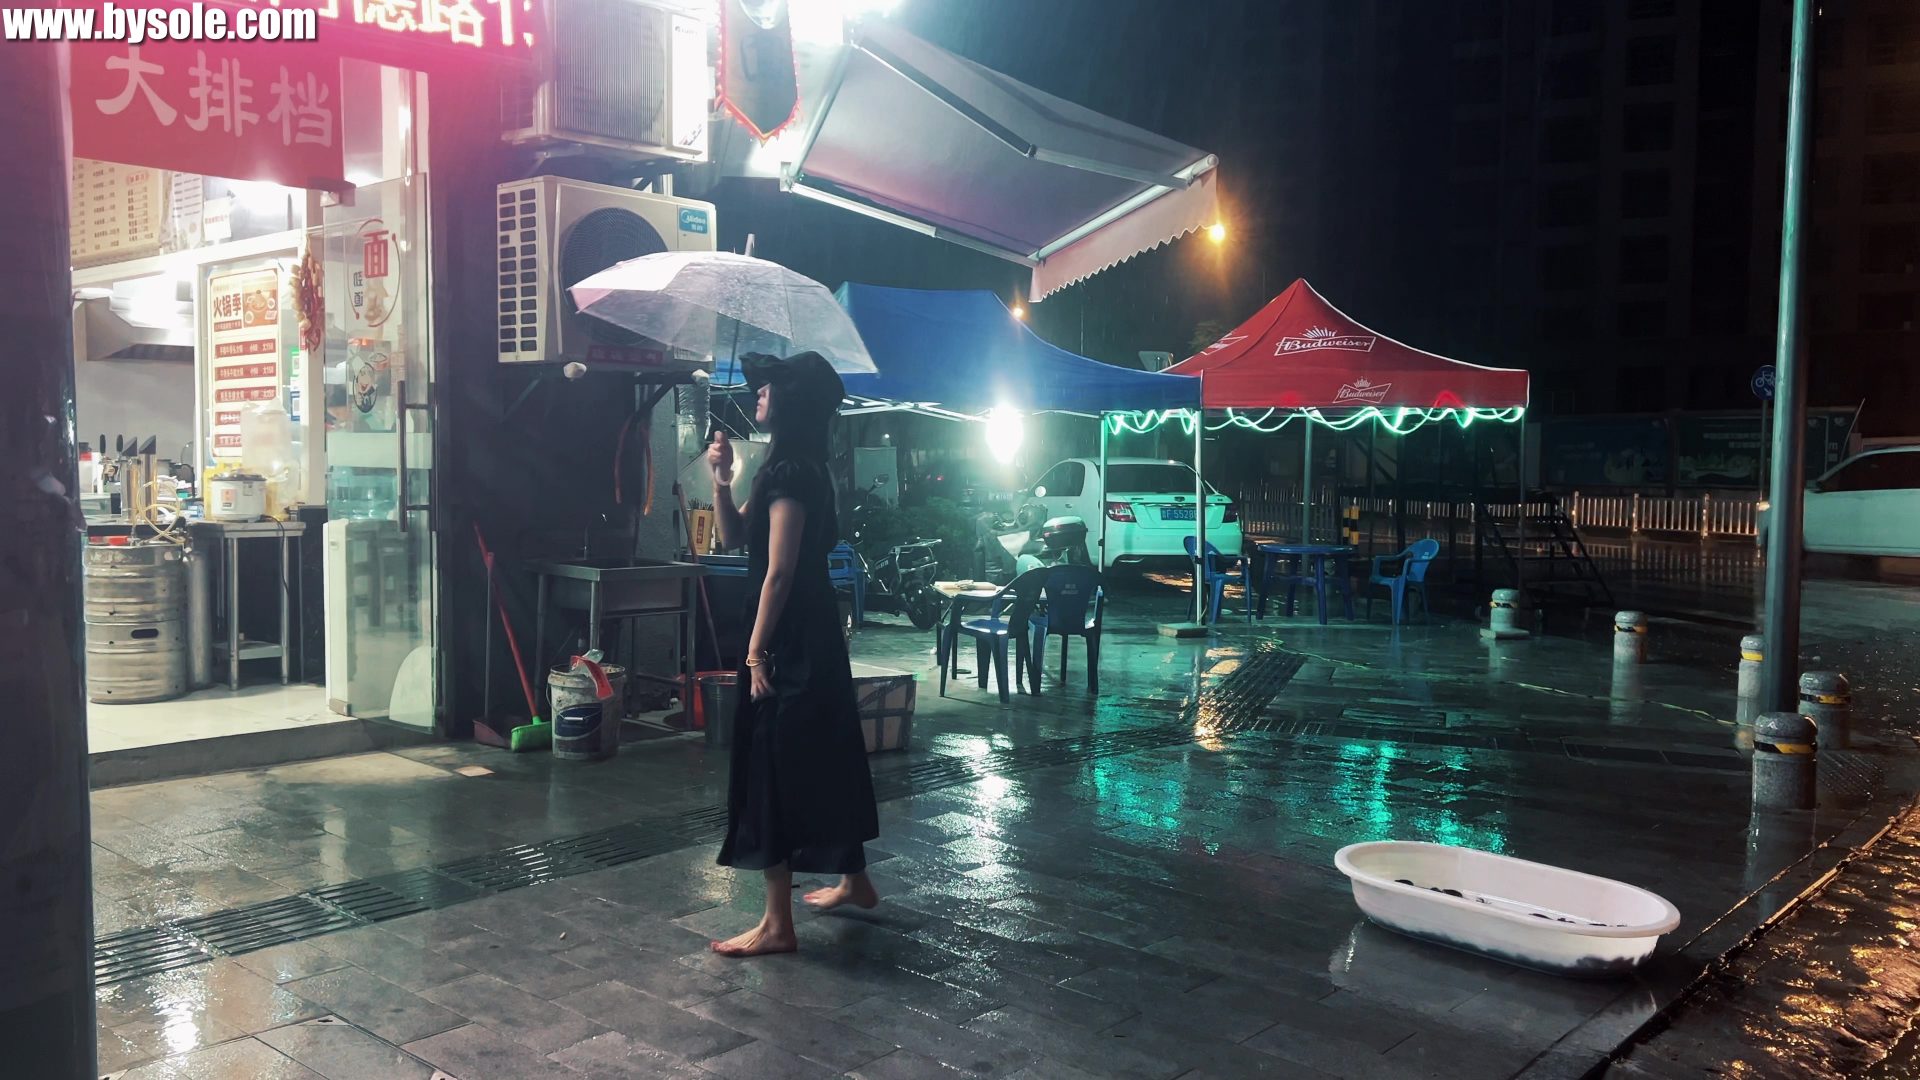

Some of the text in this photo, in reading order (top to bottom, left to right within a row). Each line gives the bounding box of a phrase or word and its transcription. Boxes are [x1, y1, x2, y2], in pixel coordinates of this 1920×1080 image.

[95, 45, 333, 148] 大排档
[213, 293, 242, 319] 火锅季
[1277, 338, 1371, 351] Budweiser
[1338, 389, 1386, 399] Budweiser
